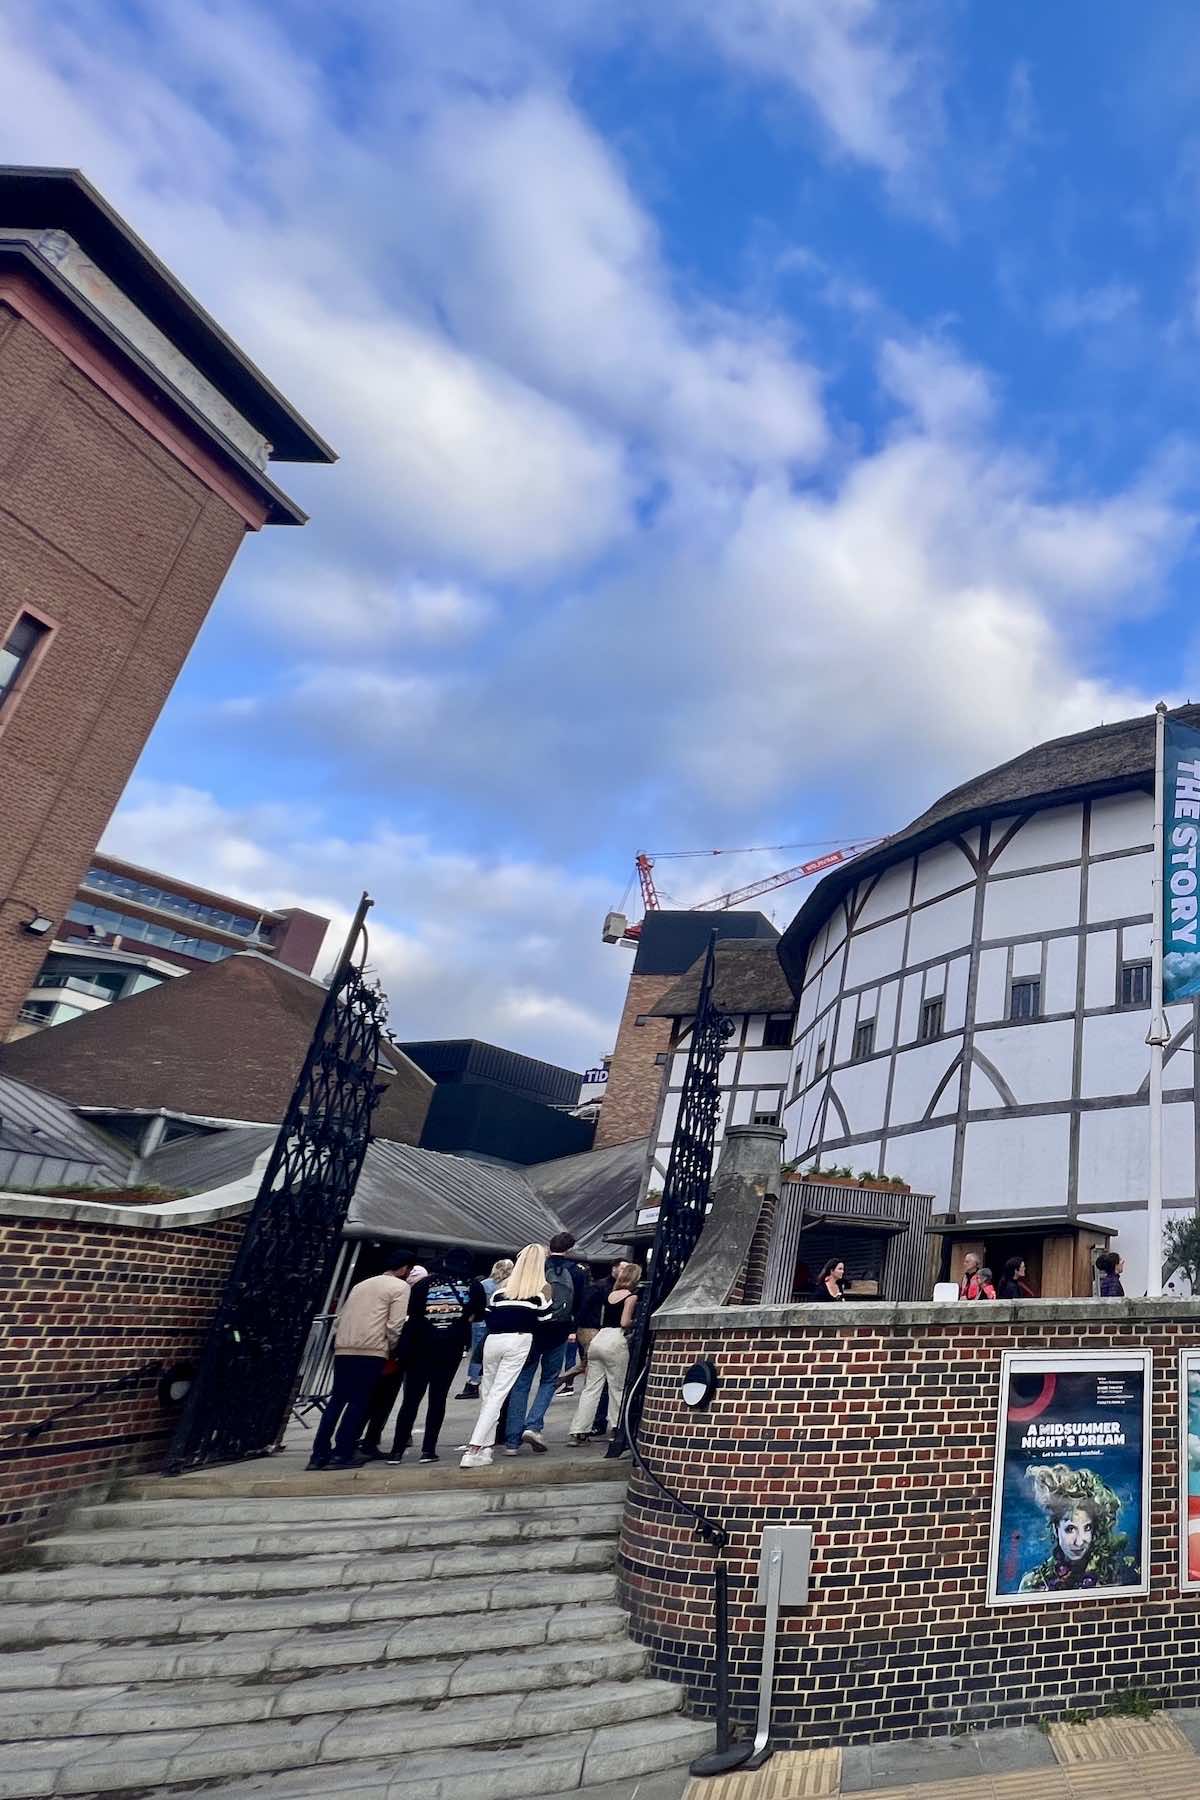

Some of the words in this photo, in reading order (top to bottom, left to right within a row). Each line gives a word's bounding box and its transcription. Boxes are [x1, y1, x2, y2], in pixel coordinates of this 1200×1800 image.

[1170, 826, 1198, 945] STORY
[1027, 1424, 1038, 1436] A
[1039, 1422, 1121, 1435] MIDSUMMER
[1021, 1434, 1076, 1449] NIGHT'S
[1078, 1434, 1126, 1447] DREAM
